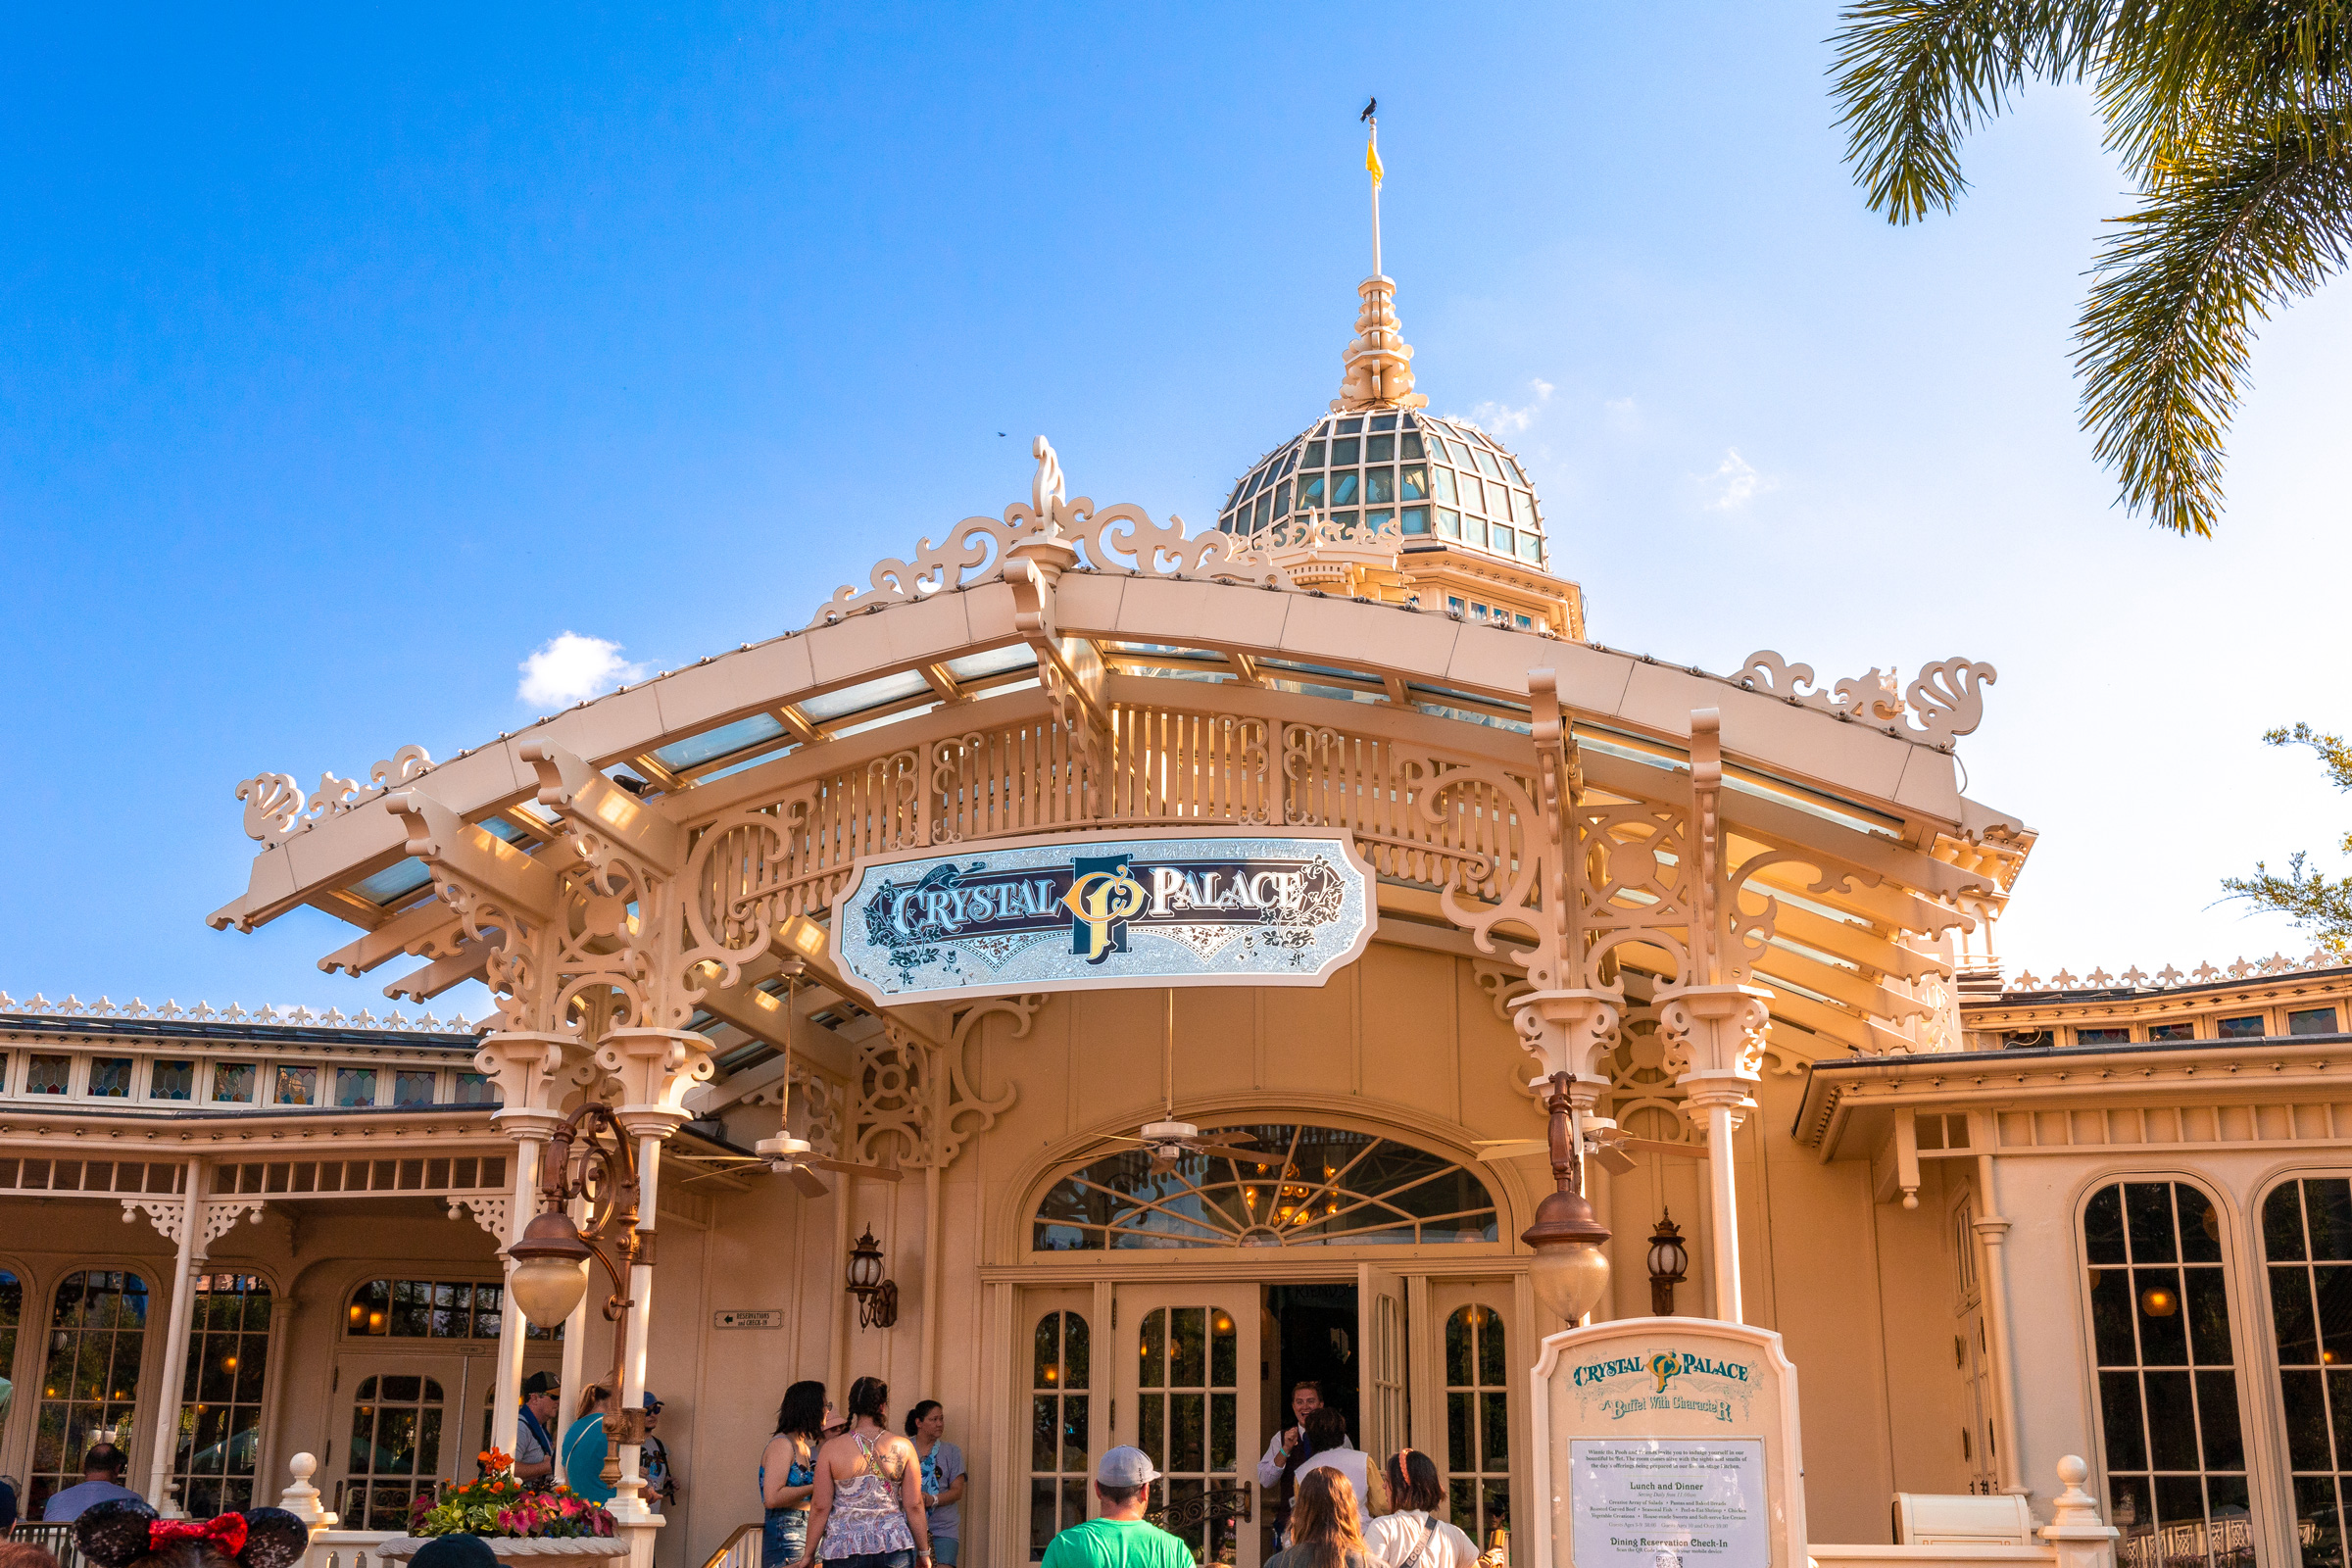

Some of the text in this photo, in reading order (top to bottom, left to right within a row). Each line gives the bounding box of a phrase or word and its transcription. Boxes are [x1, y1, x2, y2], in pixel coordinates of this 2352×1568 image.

[890, 878, 1066, 935] CRYSTAL
[1149, 865, 1306, 917] PALACE
[1573, 1356, 1645, 1386] CRYSTAL
[1681, 1353, 1749, 1382] PALACE
[1611, 1398, 1646, 1420] Buffet
[1649, 1396, 1670, 1410] With
[1658, 1482, 1673, 1490] and
[1675, 1482, 1703, 1490] Dinner
[1610, 1538, 1728, 1547] Dining Reservation Check-In
